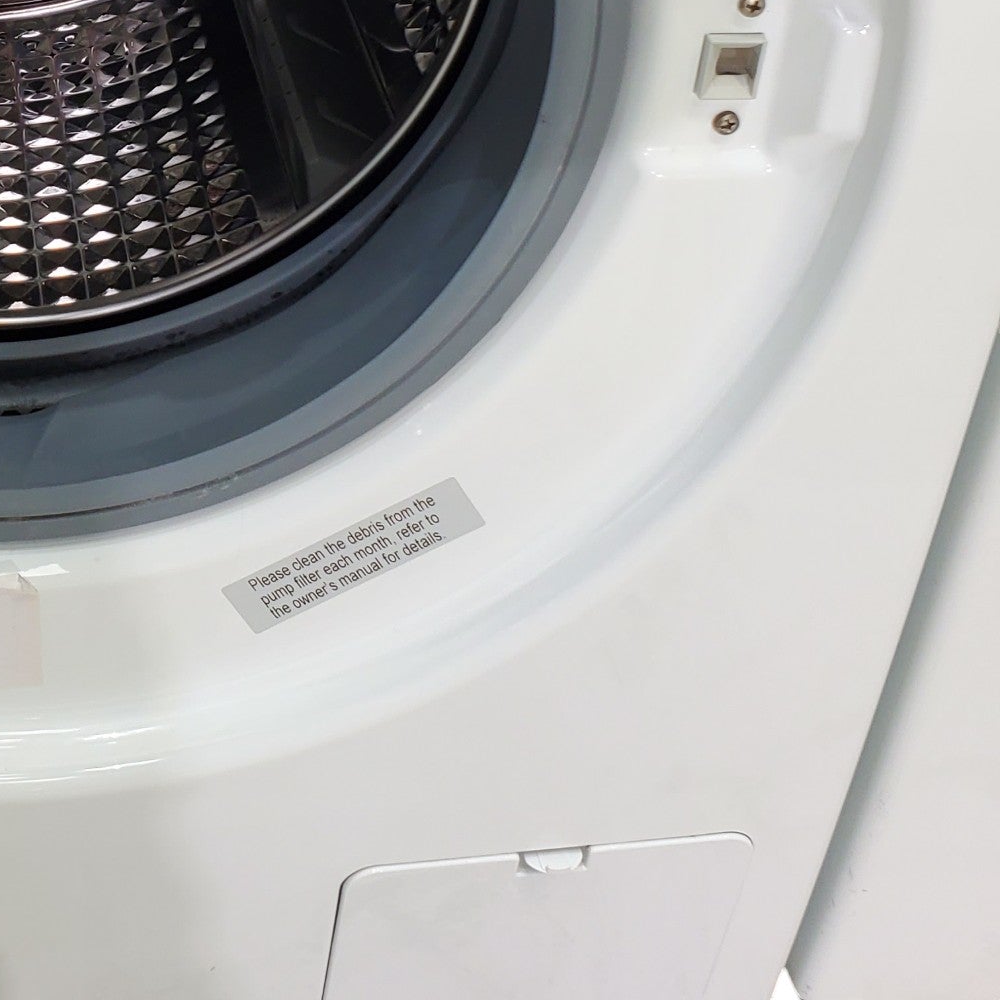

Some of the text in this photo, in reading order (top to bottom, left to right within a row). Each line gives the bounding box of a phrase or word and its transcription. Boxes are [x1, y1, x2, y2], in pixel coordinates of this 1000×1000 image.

[247, 493, 436, 592] Please clean the debris from the
[260, 510, 441, 609] pump filter each month, refer to
[268, 526, 446, 619] the owner's manual for details.
